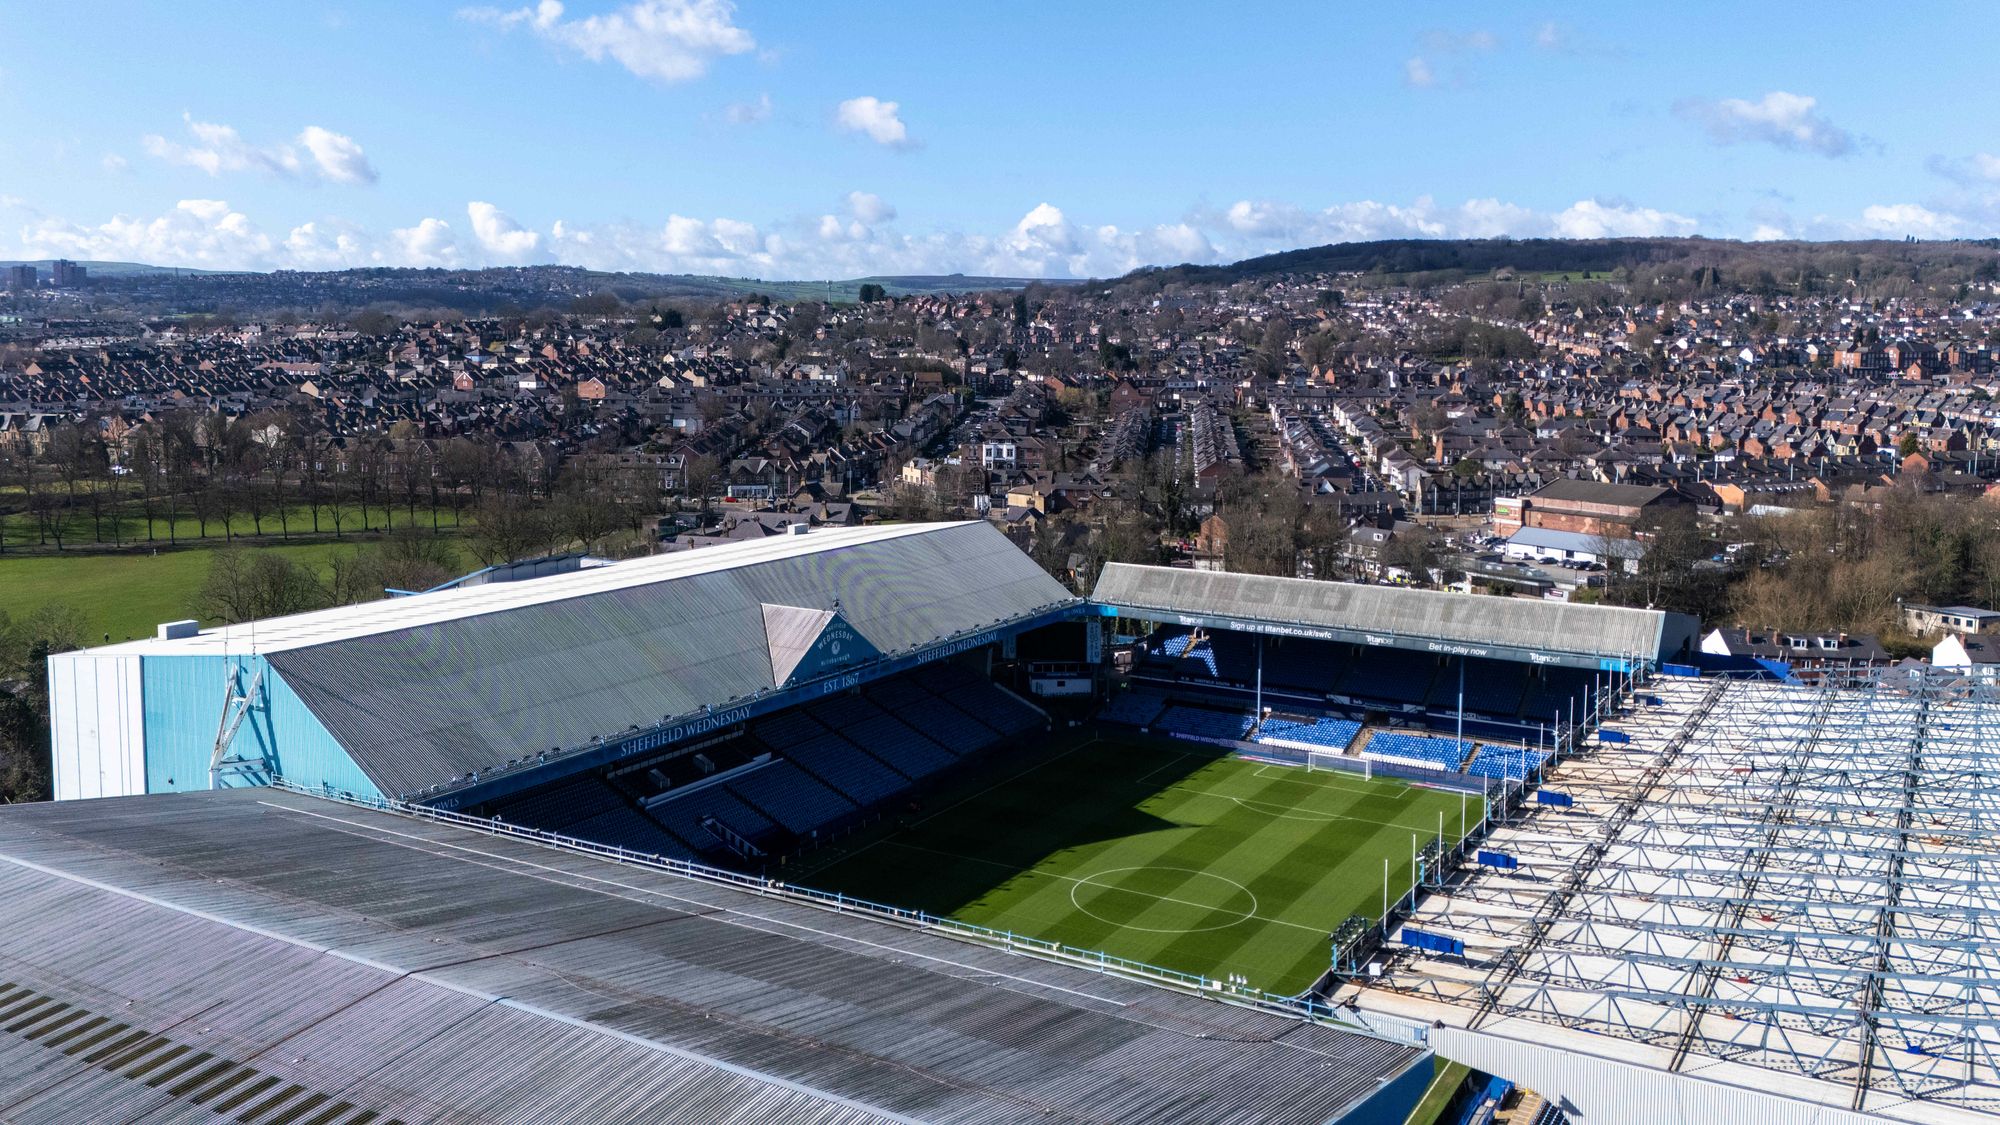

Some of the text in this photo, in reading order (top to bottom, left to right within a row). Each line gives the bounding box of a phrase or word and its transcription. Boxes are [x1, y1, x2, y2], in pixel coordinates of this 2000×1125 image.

[1178, 615, 1204, 625] Titanbet
[1230, 621, 1246, 631] Sign
[1246, 623, 1256, 632] up
[1264, 624, 1333, 640] titanbet.co.uk/swfc
[818, 630, 853, 650] WEDNESDAY
[917, 642, 956, 665] SHEFFIELD
[957, 631, 998, 655] WEDNESDAY
[1365, 635, 1394, 646] Titanbet
[1428, 642, 1488, 656] Bet in-play now
[1529, 652, 1561, 664] Titanbet
[823, 672, 860, 694] EST. 1867
[620, 704, 752, 757] SHEFFIELD WEDNESDAY
[432, 798, 460, 811] OWLS
